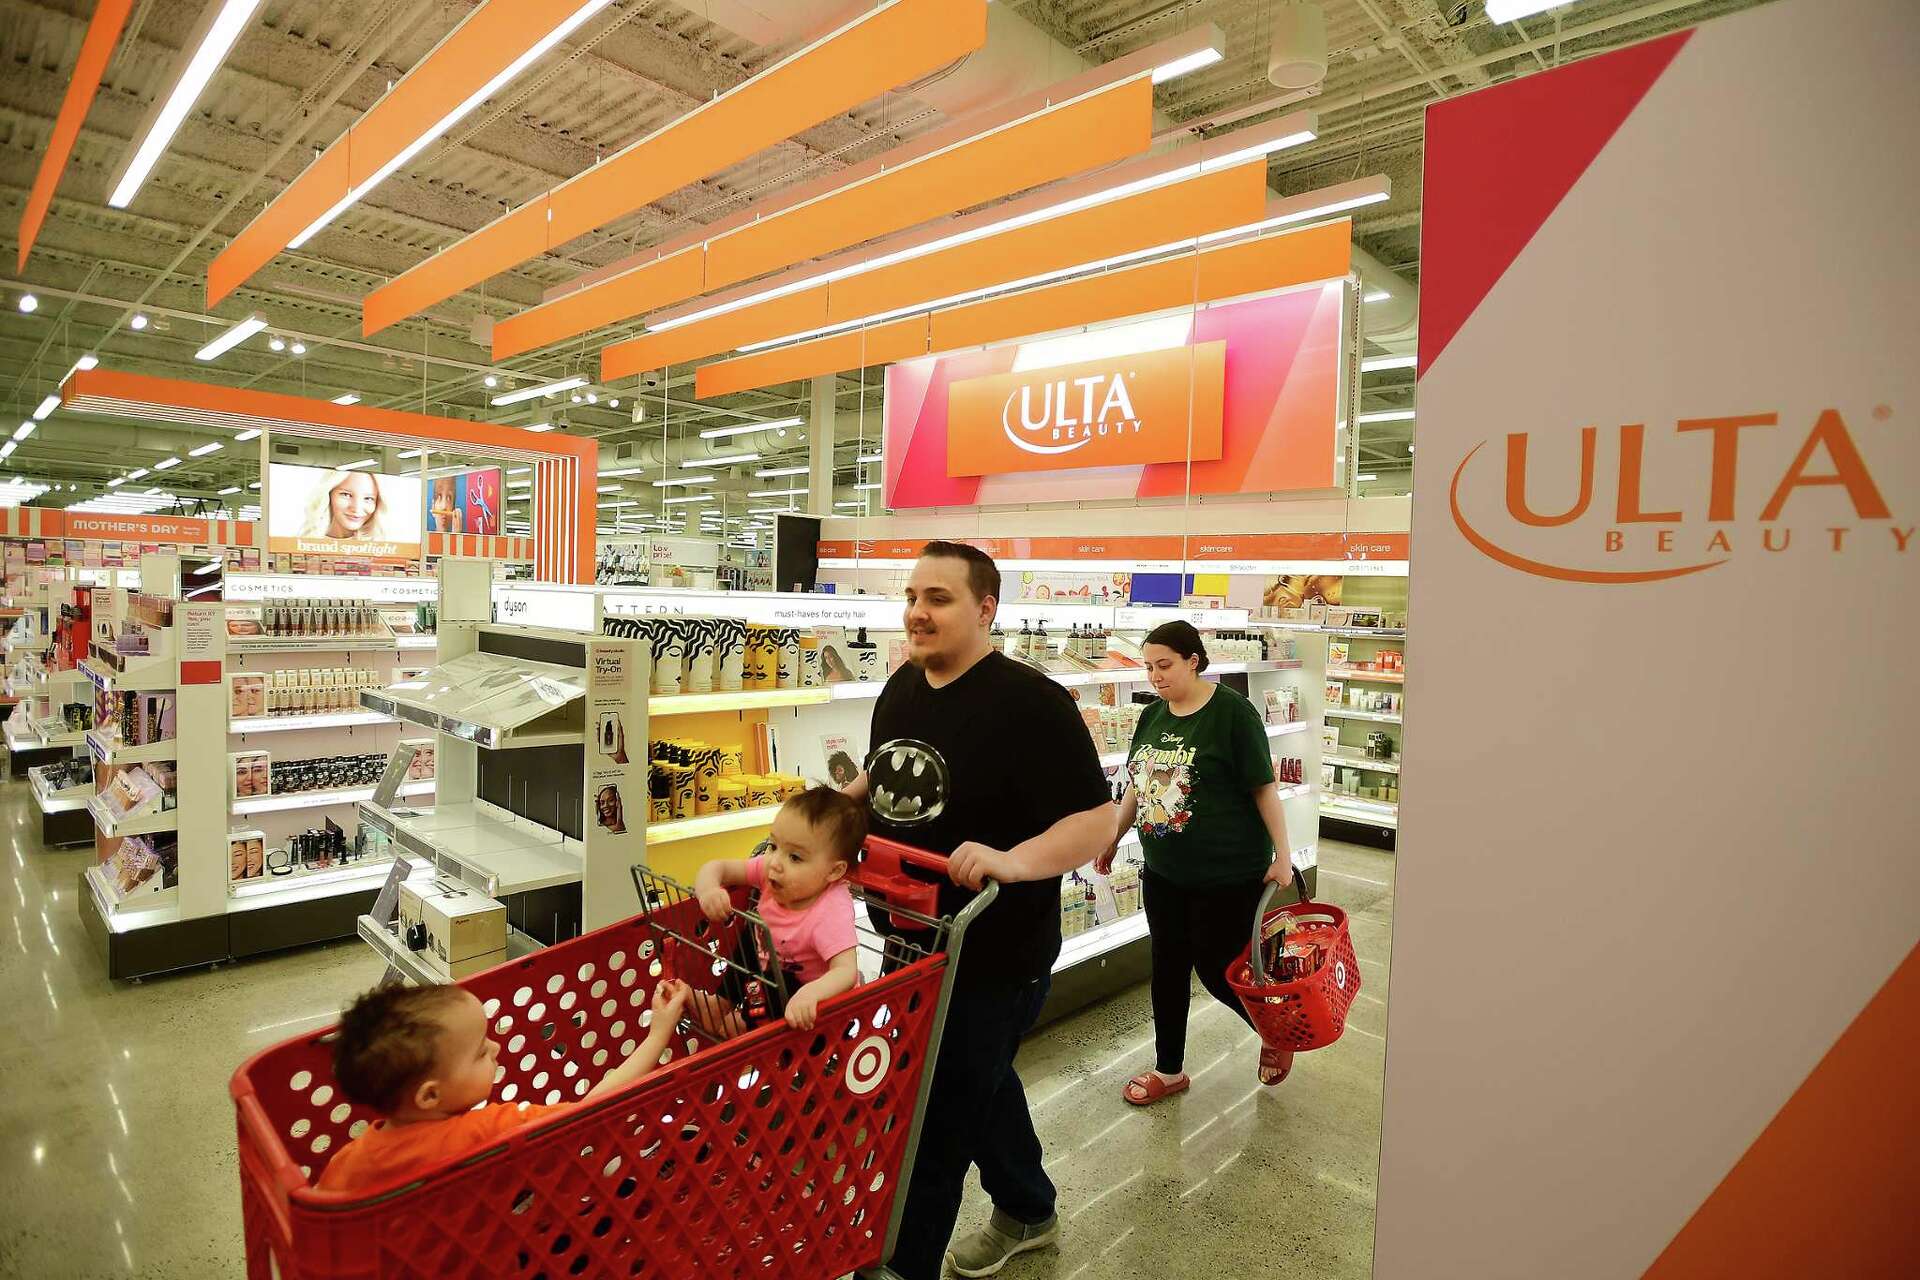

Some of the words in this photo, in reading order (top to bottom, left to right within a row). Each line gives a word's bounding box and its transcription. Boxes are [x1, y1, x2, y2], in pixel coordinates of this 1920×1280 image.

[1021, 373, 1136, 431] ULTA
[1052, 420, 1143, 440] BEAUTY
[1505, 409, 1893, 528] ULTA
[73, 519, 148, 533] MOTHER'S
[151, 524, 180, 534] DAY
[1604, 527, 1917, 553] BEAUTY
[296, 540, 338, 552] brand
[340, 543, 399, 556] spotlight
[1350, 544, 1369, 552] skin
[1371, 544, 1391, 552] care
[231, 584, 294, 593] COSMETICS
[504, 597, 528, 616] dyson
[774, 609, 820, 618] must-haves
[822, 610, 832, 618] for
[595, 657, 621, 665] Virtual
[595, 665, 622, 674] Try-On
